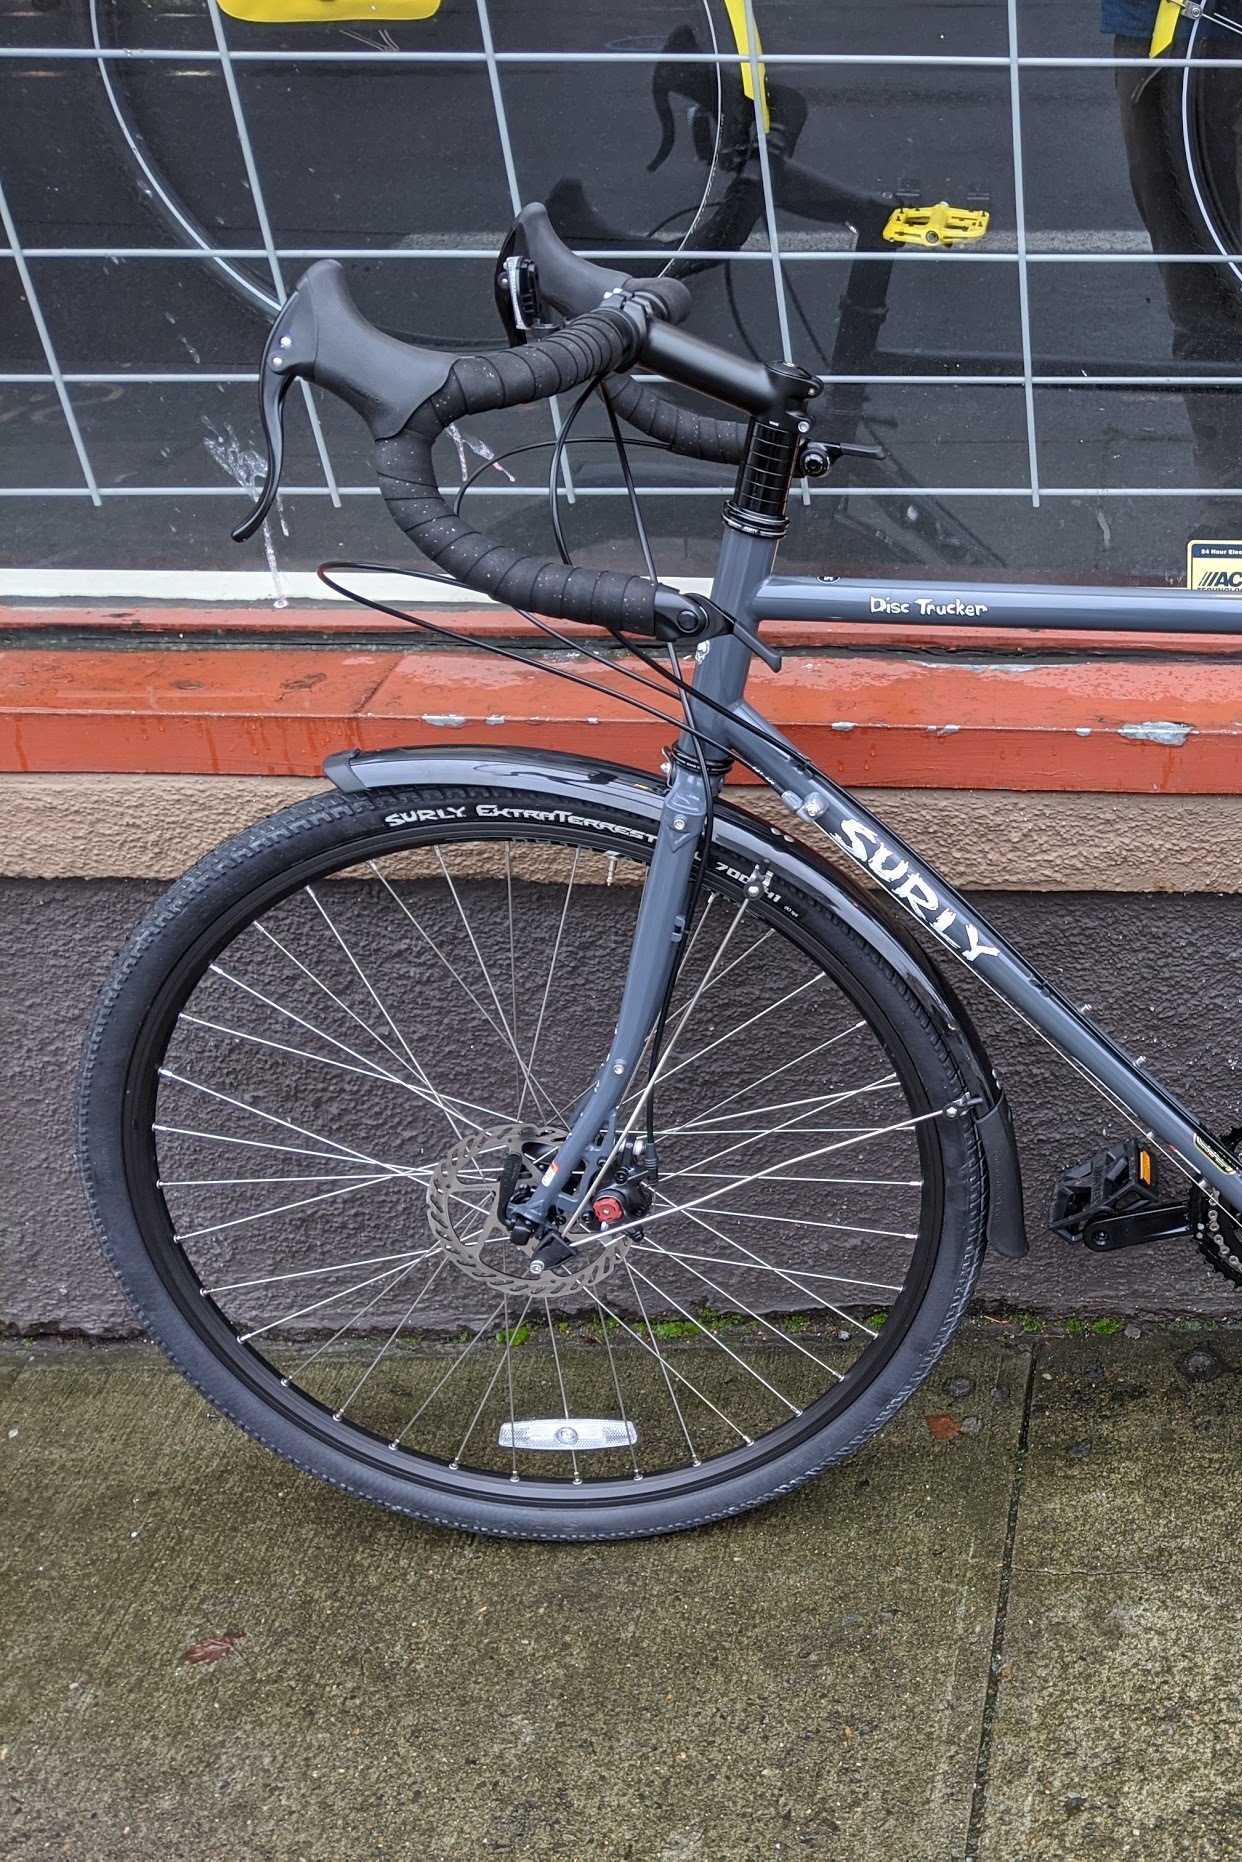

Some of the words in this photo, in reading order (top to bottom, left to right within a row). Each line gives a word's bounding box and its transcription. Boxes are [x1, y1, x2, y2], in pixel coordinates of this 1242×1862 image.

[870, 595, 910, 615] Disc
[913, 598, 988, 617] Trucker
[385, 805, 467, 828] SURLY
[715, 861, 782, 903] 70041
[829, 818, 1001, 962] SURLY
